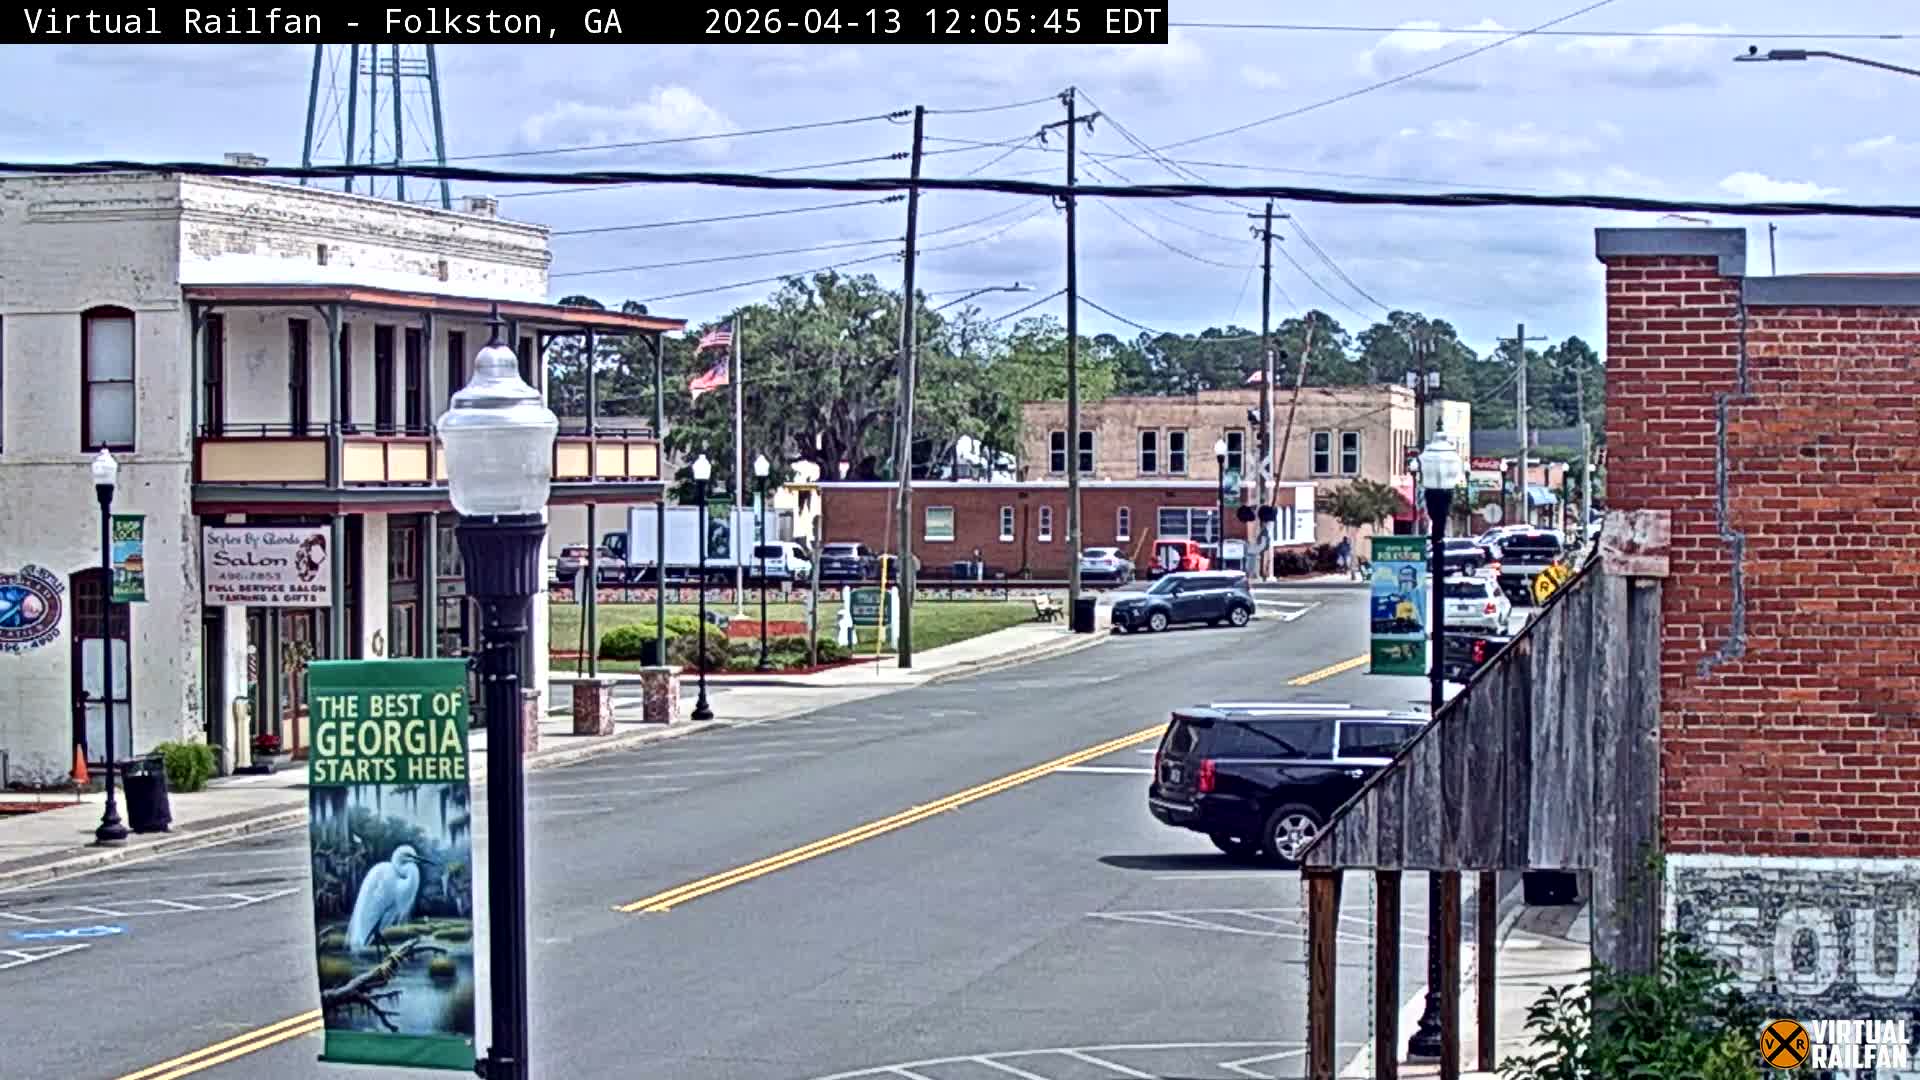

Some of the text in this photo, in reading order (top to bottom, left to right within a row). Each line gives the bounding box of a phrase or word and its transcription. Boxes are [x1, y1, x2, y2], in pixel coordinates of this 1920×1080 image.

[213, 551, 288, 566] Salon
[208, 584, 326, 592] FULL SERVICE SALON
[219, 594, 267, 602] TANNING
[284, 594, 317, 602] GIFTS
[316, 692, 462, 719] THE BEST OF
[316, 718, 464, 757] GEORGIA
[314, 756, 465, 782] STARTS HERE
